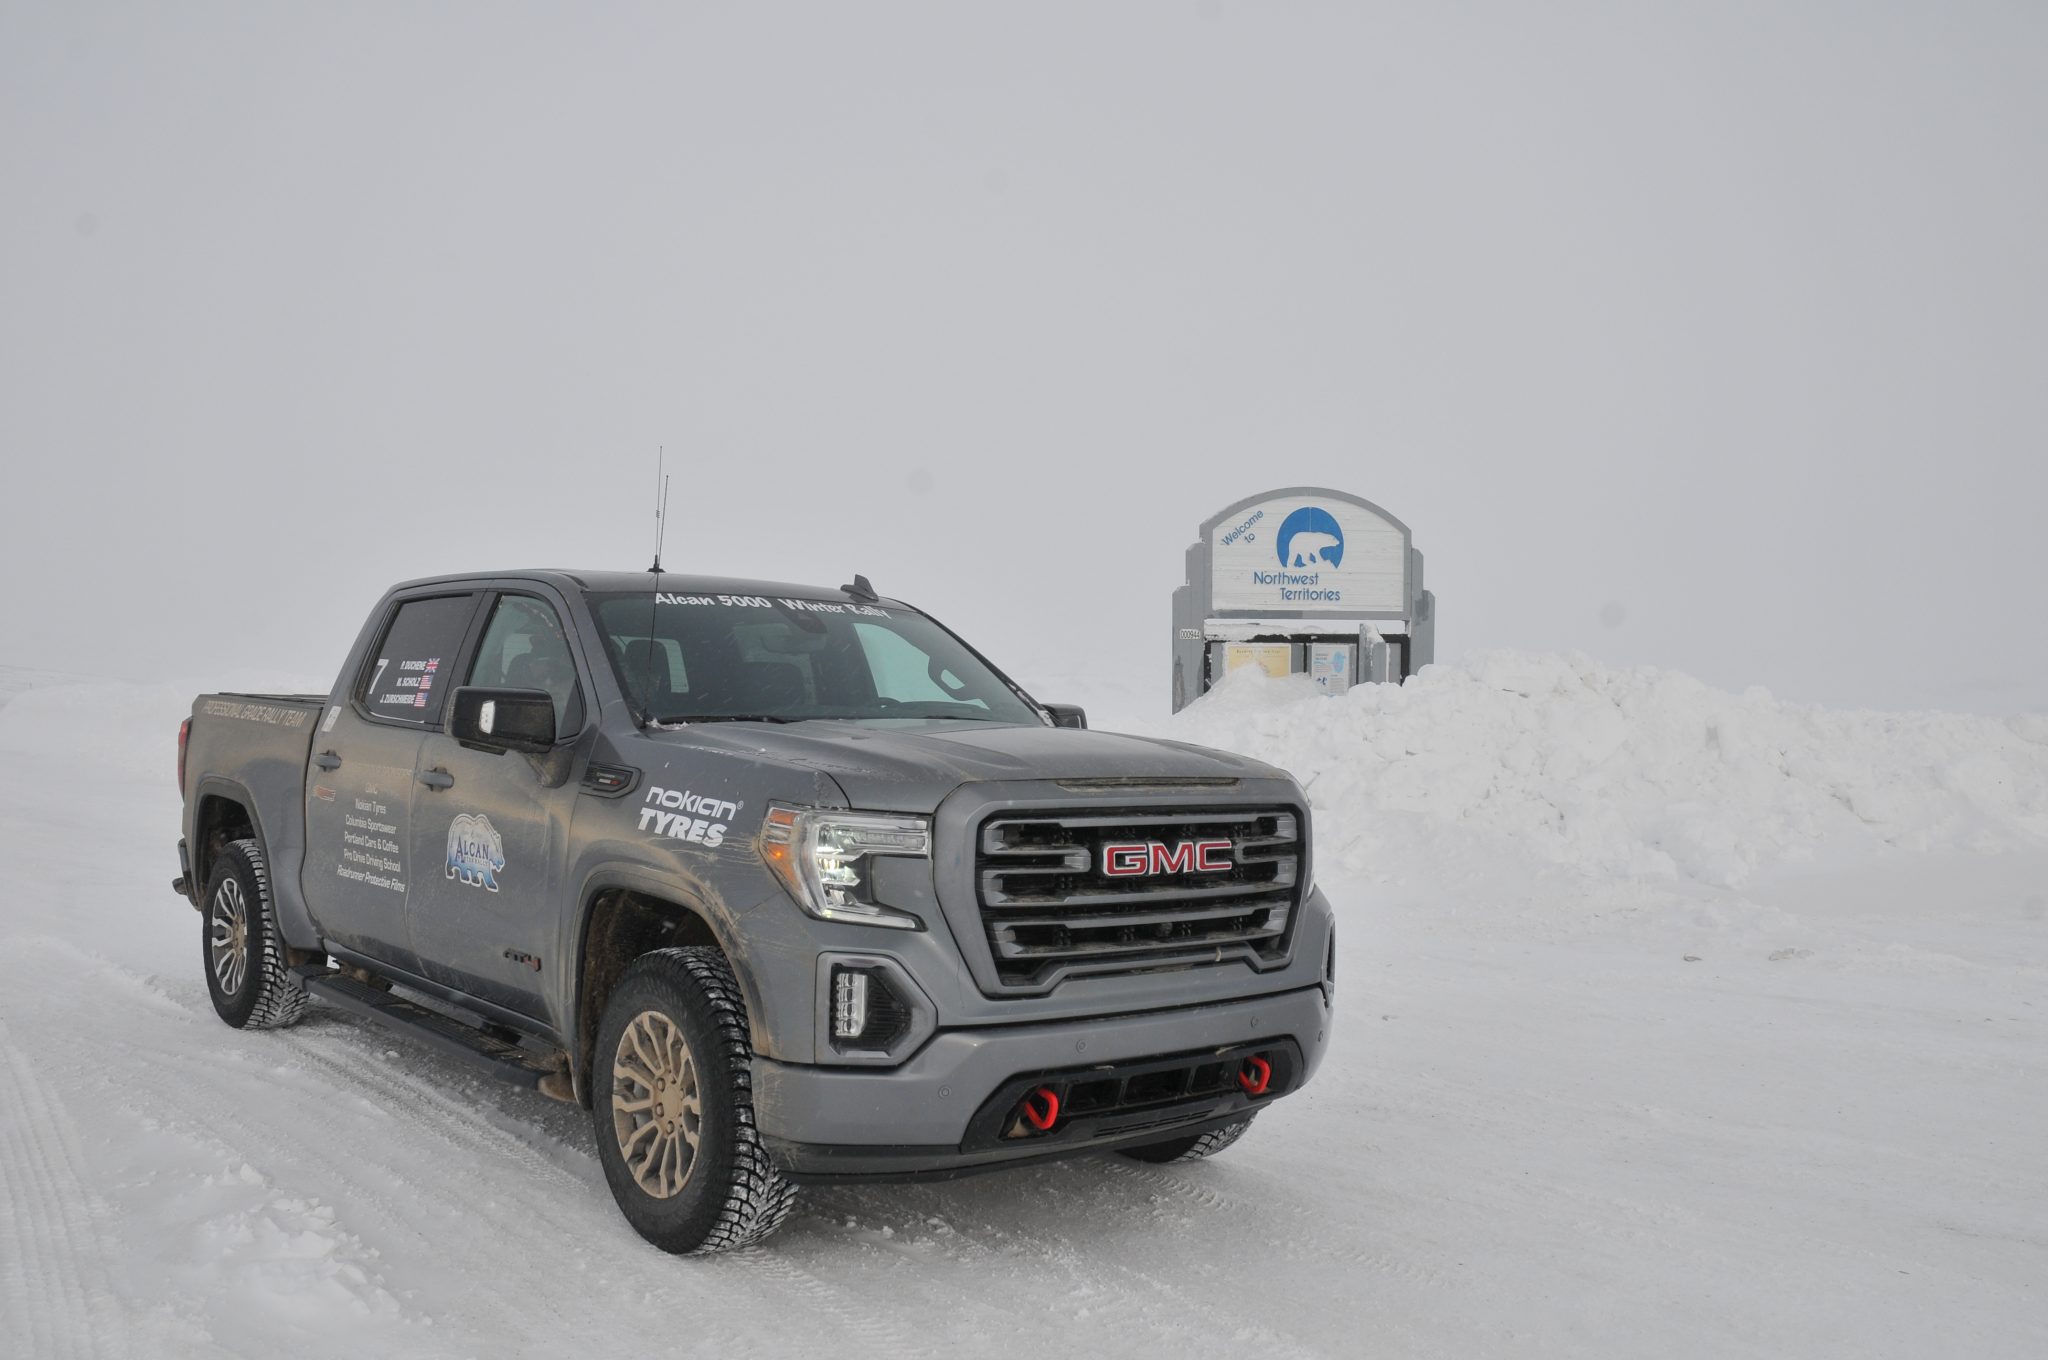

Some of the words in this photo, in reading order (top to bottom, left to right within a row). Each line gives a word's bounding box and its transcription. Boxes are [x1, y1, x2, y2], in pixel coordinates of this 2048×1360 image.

[1221, 508, 1264, 547] Welcome
[1243, 532, 1256, 544] to
[1253, 571, 1320, 586] Northwest
[655, 592, 714, 606] Alcan
[716, 595, 773, 609] 5000
[777, 598, 847, 614] Winter
[845, 603, 893, 620] Rally
[1280, 587, 1341, 602] Territories
[369, 658, 389, 694] 7
[355, 798, 372, 812] Nokian
[372, 801, 387, 816] Tyres
[345, 813, 367, 829] Columbia
[367, 818, 397, 835] Sportswear
[638, 807, 728, 848] TYRES
[344, 831, 365, 846] Portland
[364, 835, 377, 849] Cars
[382, 839, 399, 854] Coffee
[455, 835, 489, 863] ALCAN
[343, 848, 353, 861] Pro
[352, 850, 366, 864] Drive
[365, 853, 384, 871] Driving
[383, 857, 401, 873] School
[1103, 840, 1233, 877] GMC
[336, 864, 366, 881] Roadrunner
[364, 871, 391, 889] Protective
[390, 878, 406, 893] Films
